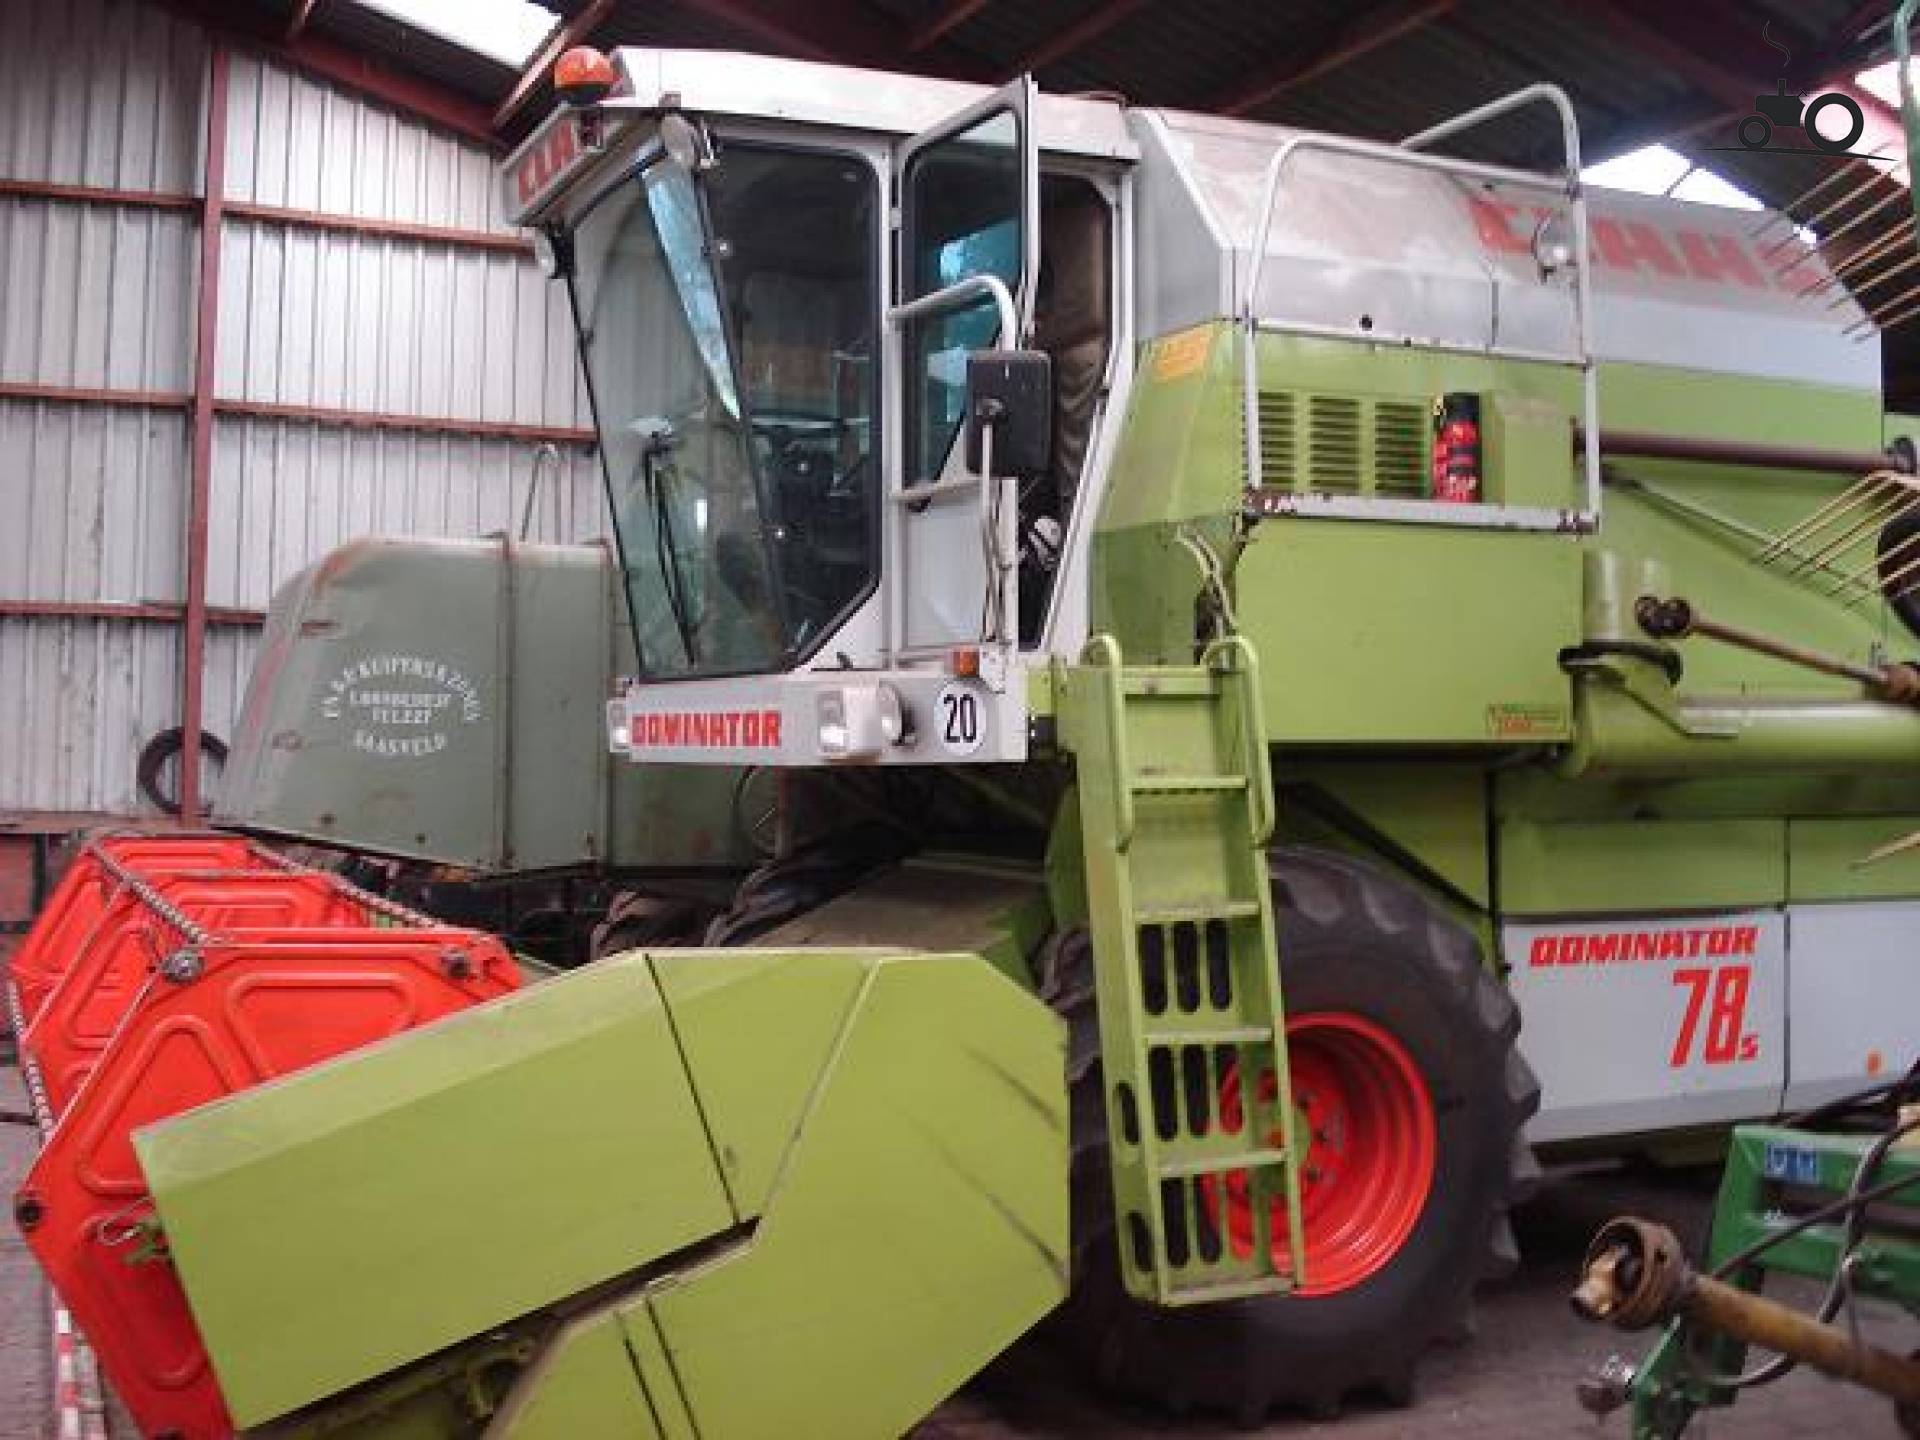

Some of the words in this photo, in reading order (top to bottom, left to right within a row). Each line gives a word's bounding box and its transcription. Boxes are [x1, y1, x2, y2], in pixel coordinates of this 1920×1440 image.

[631, 710, 781, 747] DOMINATOR
[942, 693, 977, 744] 20
[1530, 925, 1759, 967] DOMINATOR
